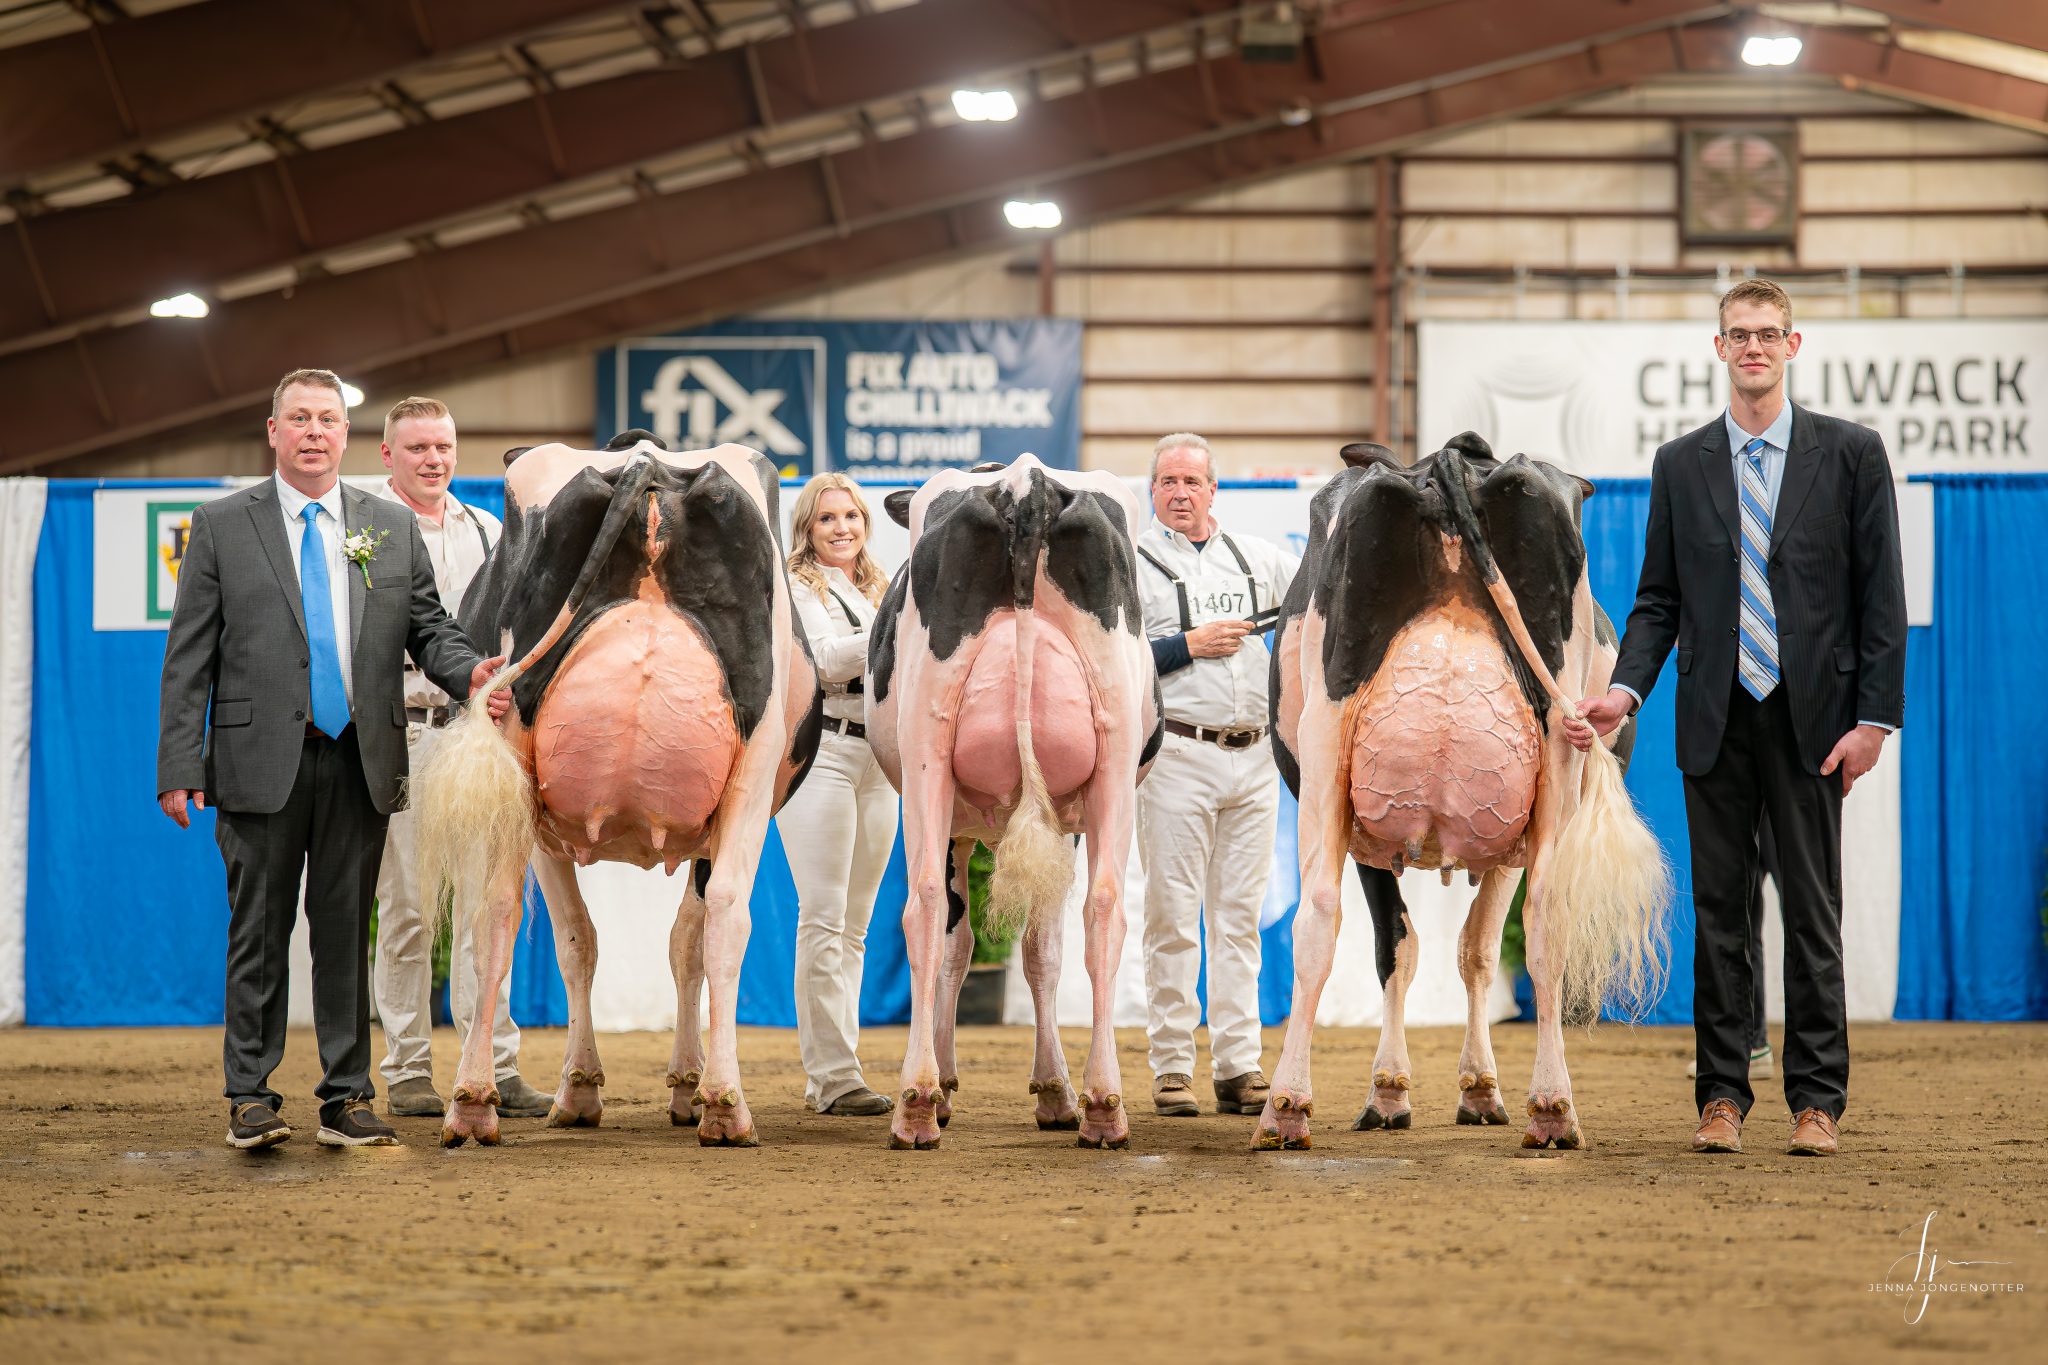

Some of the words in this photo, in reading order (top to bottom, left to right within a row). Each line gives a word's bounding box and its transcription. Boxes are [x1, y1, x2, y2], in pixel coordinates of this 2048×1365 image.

[846, 352, 904, 389] FIX
[907, 352, 999, 389] AUTO
[1638, 360, 2026, 406] CHLIWACK
[641, 355, 806, 455] fix
[845, 388, 1053, 428] CHILLIWACK
[845, 428, 874, 461] is
[876, 432, 898, 461] a
[899, 429, 981, 465] proud
[1900, 417, 2028, 455] PARK
[1192, 592, 1245, 614] 1407
